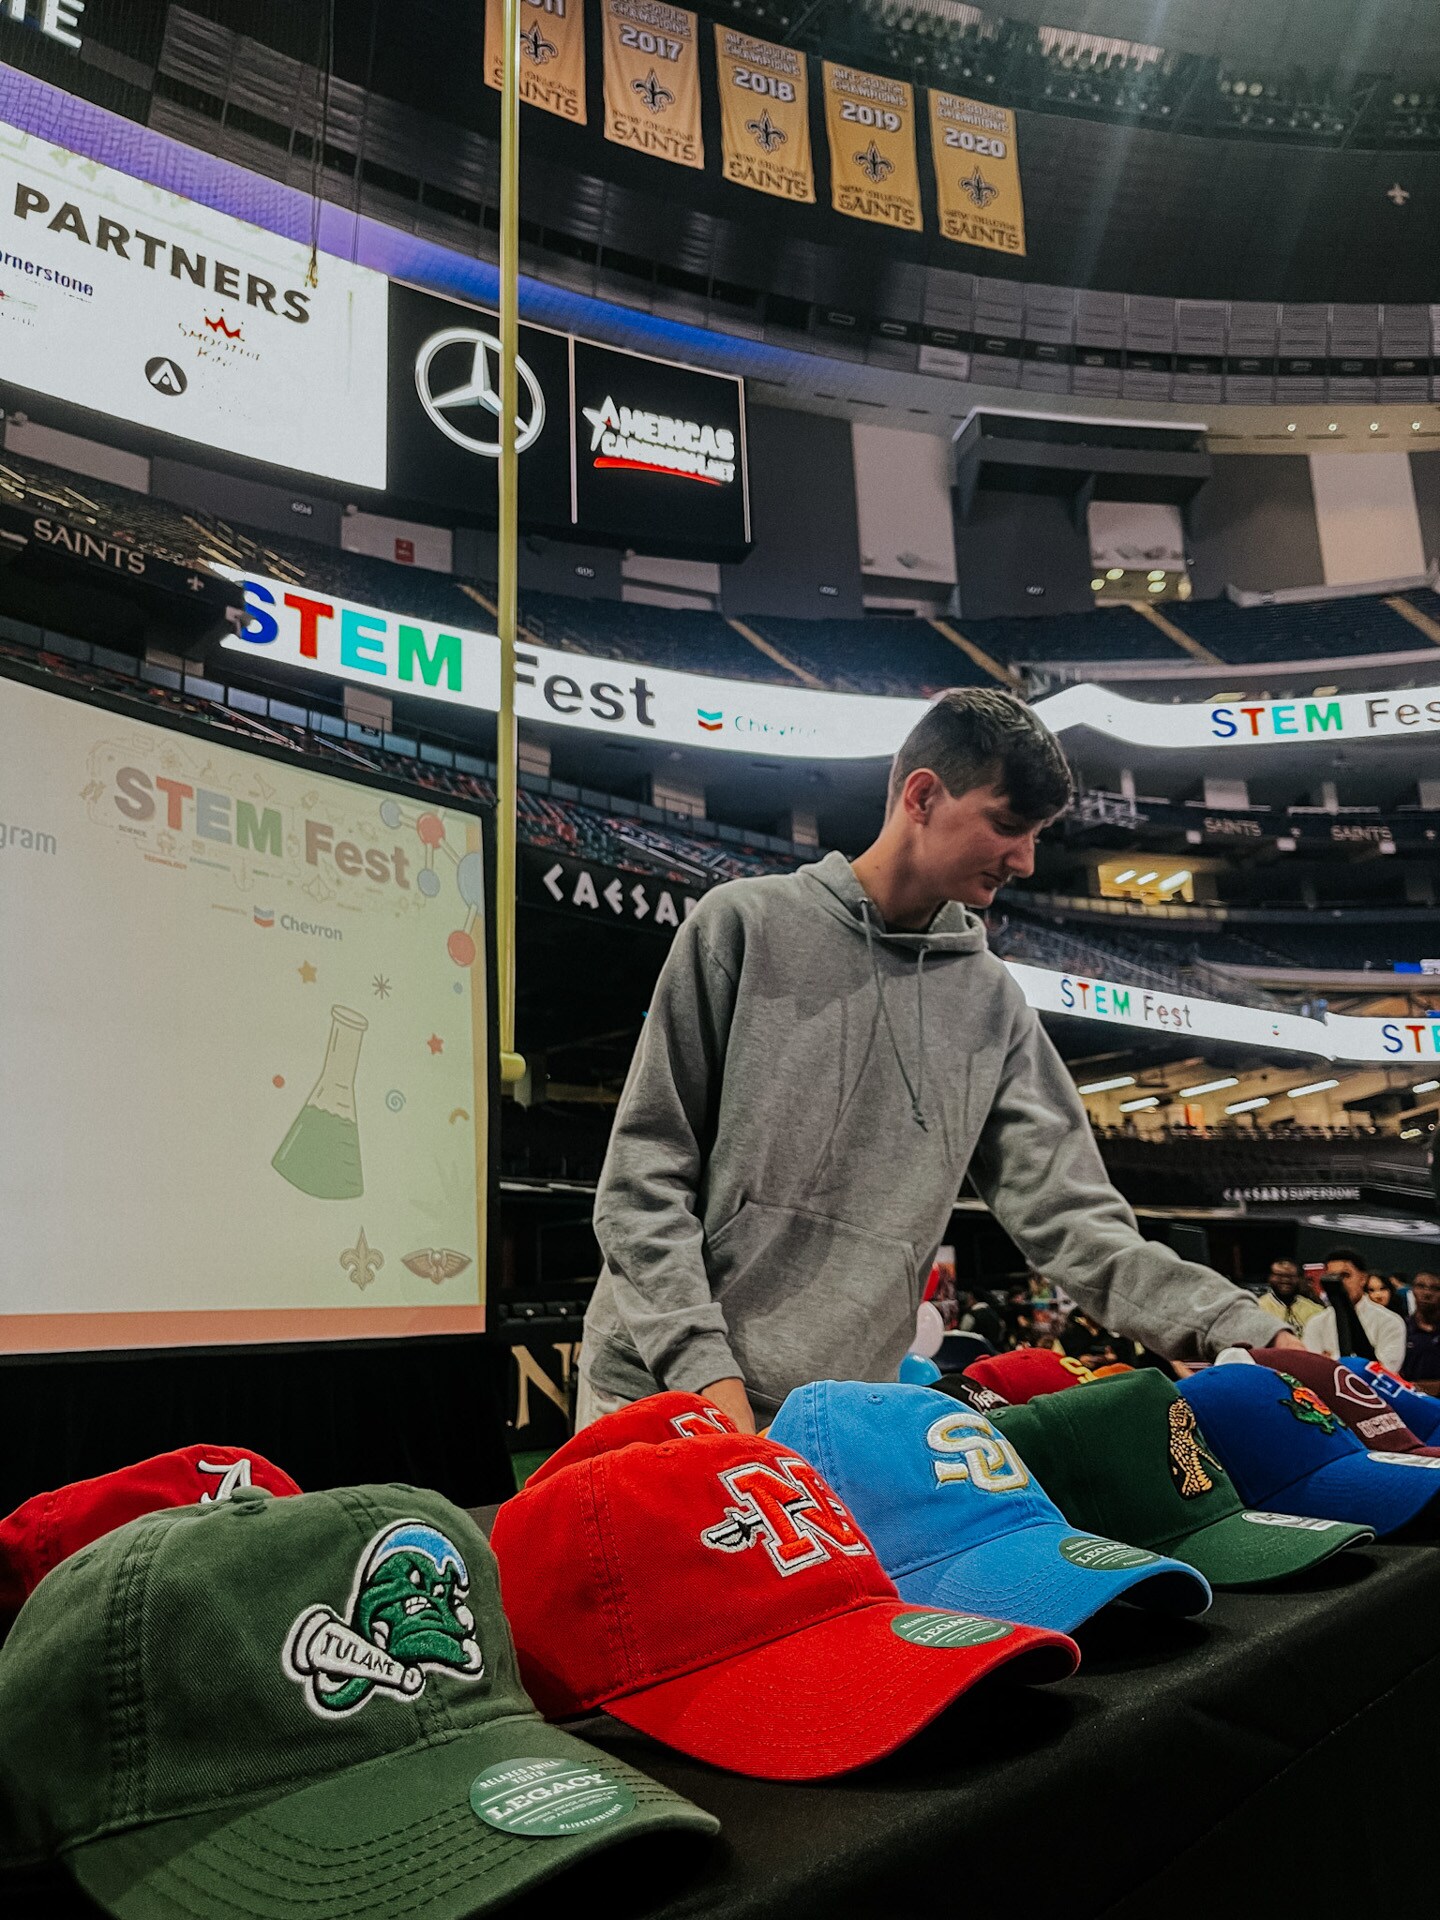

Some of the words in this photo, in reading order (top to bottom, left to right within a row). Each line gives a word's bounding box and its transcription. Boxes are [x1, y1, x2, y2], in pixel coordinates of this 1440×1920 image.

[620, 24, 682, 62] 2017
[493, 66, 579, 117] SINTS
[733, 66, 796, 103] 2018
[840, 100, 902, 133] 2019
[613, 121, 697, 161] SAINTS
[944, 126, 1006, 159] 2020
[728, 161, 808, 199] SAINTS
[838, 193, 916, 227] SAINTS
[13, 182, 311, 325] PARTNERS
[944, 219, 1019, 251] SAINTS
[0, 250, 94, 297] rnerstone
[34, 517, 147, 575] SAINTS
[241, 580, 462, 693] STEM
[1211, 702, 1343, 738] STEM
[114, 766, 283, 857] STEM
[304, 819, 411, 890] Fest
[1204, 817, 1263, 837] SAINTS
[1330, 825, 1393, 842] SAINTS
[279, 913, 343, 942] Chevron
[1061, 979, 1131, 1018] STEM
[1143, 993, 1193, 1029] Fest
[914, 1616, 984, 1643] LEGACY
[320, 1631, 395, 1676] TULANE
[479, 1767, 527, 1789] RELAXED
[527, 1760, 561, 1772] TWILL
[511, 1770, 547, 1784] YOUTH
[485, 1773, 608, 1821] LEGACY
